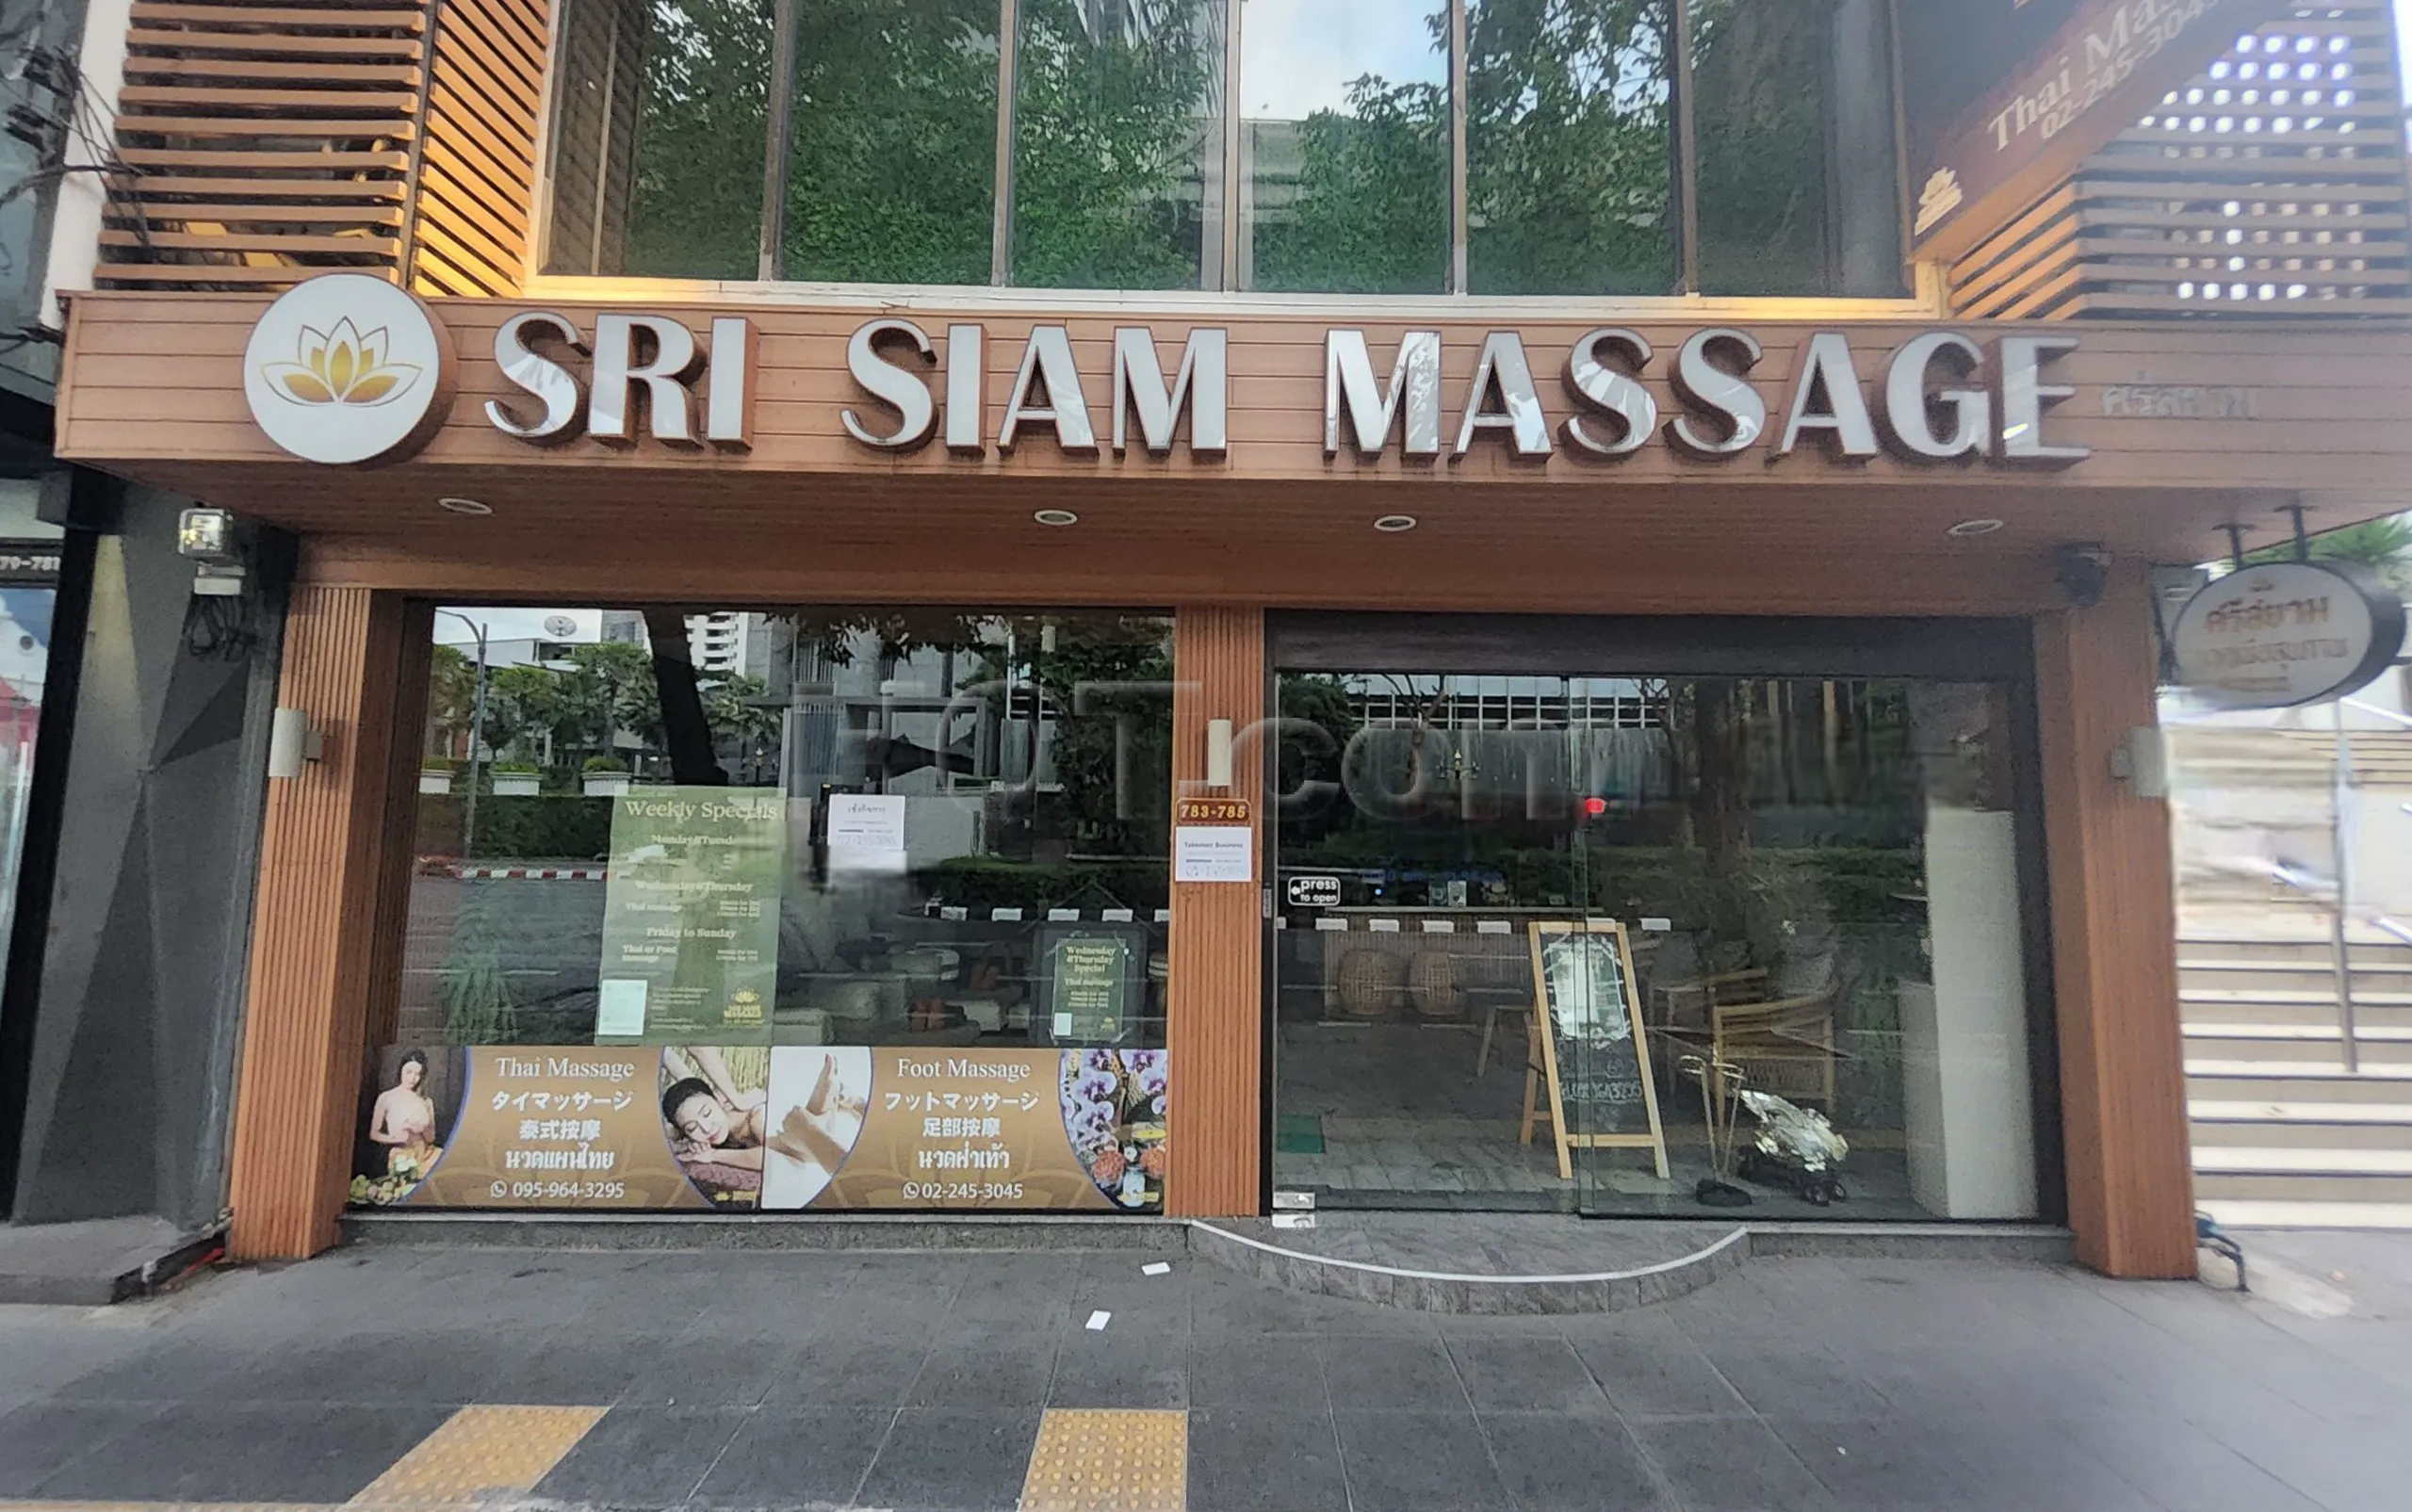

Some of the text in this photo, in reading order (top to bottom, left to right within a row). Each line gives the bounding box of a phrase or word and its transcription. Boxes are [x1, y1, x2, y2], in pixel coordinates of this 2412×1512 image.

[1987, 56, 2072, 153] Thai
[483, 310, 2092, 471] SRI SIAM MASSAGE
[624, 800, 697, 823] Weekly
[1181, 805, 1247, 819] 783-785
[1300, 880, 1337, 893] press
[1312, 894, 1337, 904] open
[646, 927, 737, 940] Friday to Sunday
[495, 1056, 636, 1082] Thai Massage
[897, 1058, 1033, 1082] Foot Massage
[491, 1090, 635, 1112] タイマッサージ
[884, 1091, 1040, 1112] フットマッサージ
[519, 1118, 602, 1141] 泰式按摩
[922, 1116, 1002, 1138] 足部按摩
[504, 1141, 615, 1170] นวดแผนไทย
[918, 1141, 1011, 1170] นวดฝ่าเท้า
[511, 1181, 625, 1199] 095-964-3295
[921, 1182, 1024, 1199] 02-245-3045
